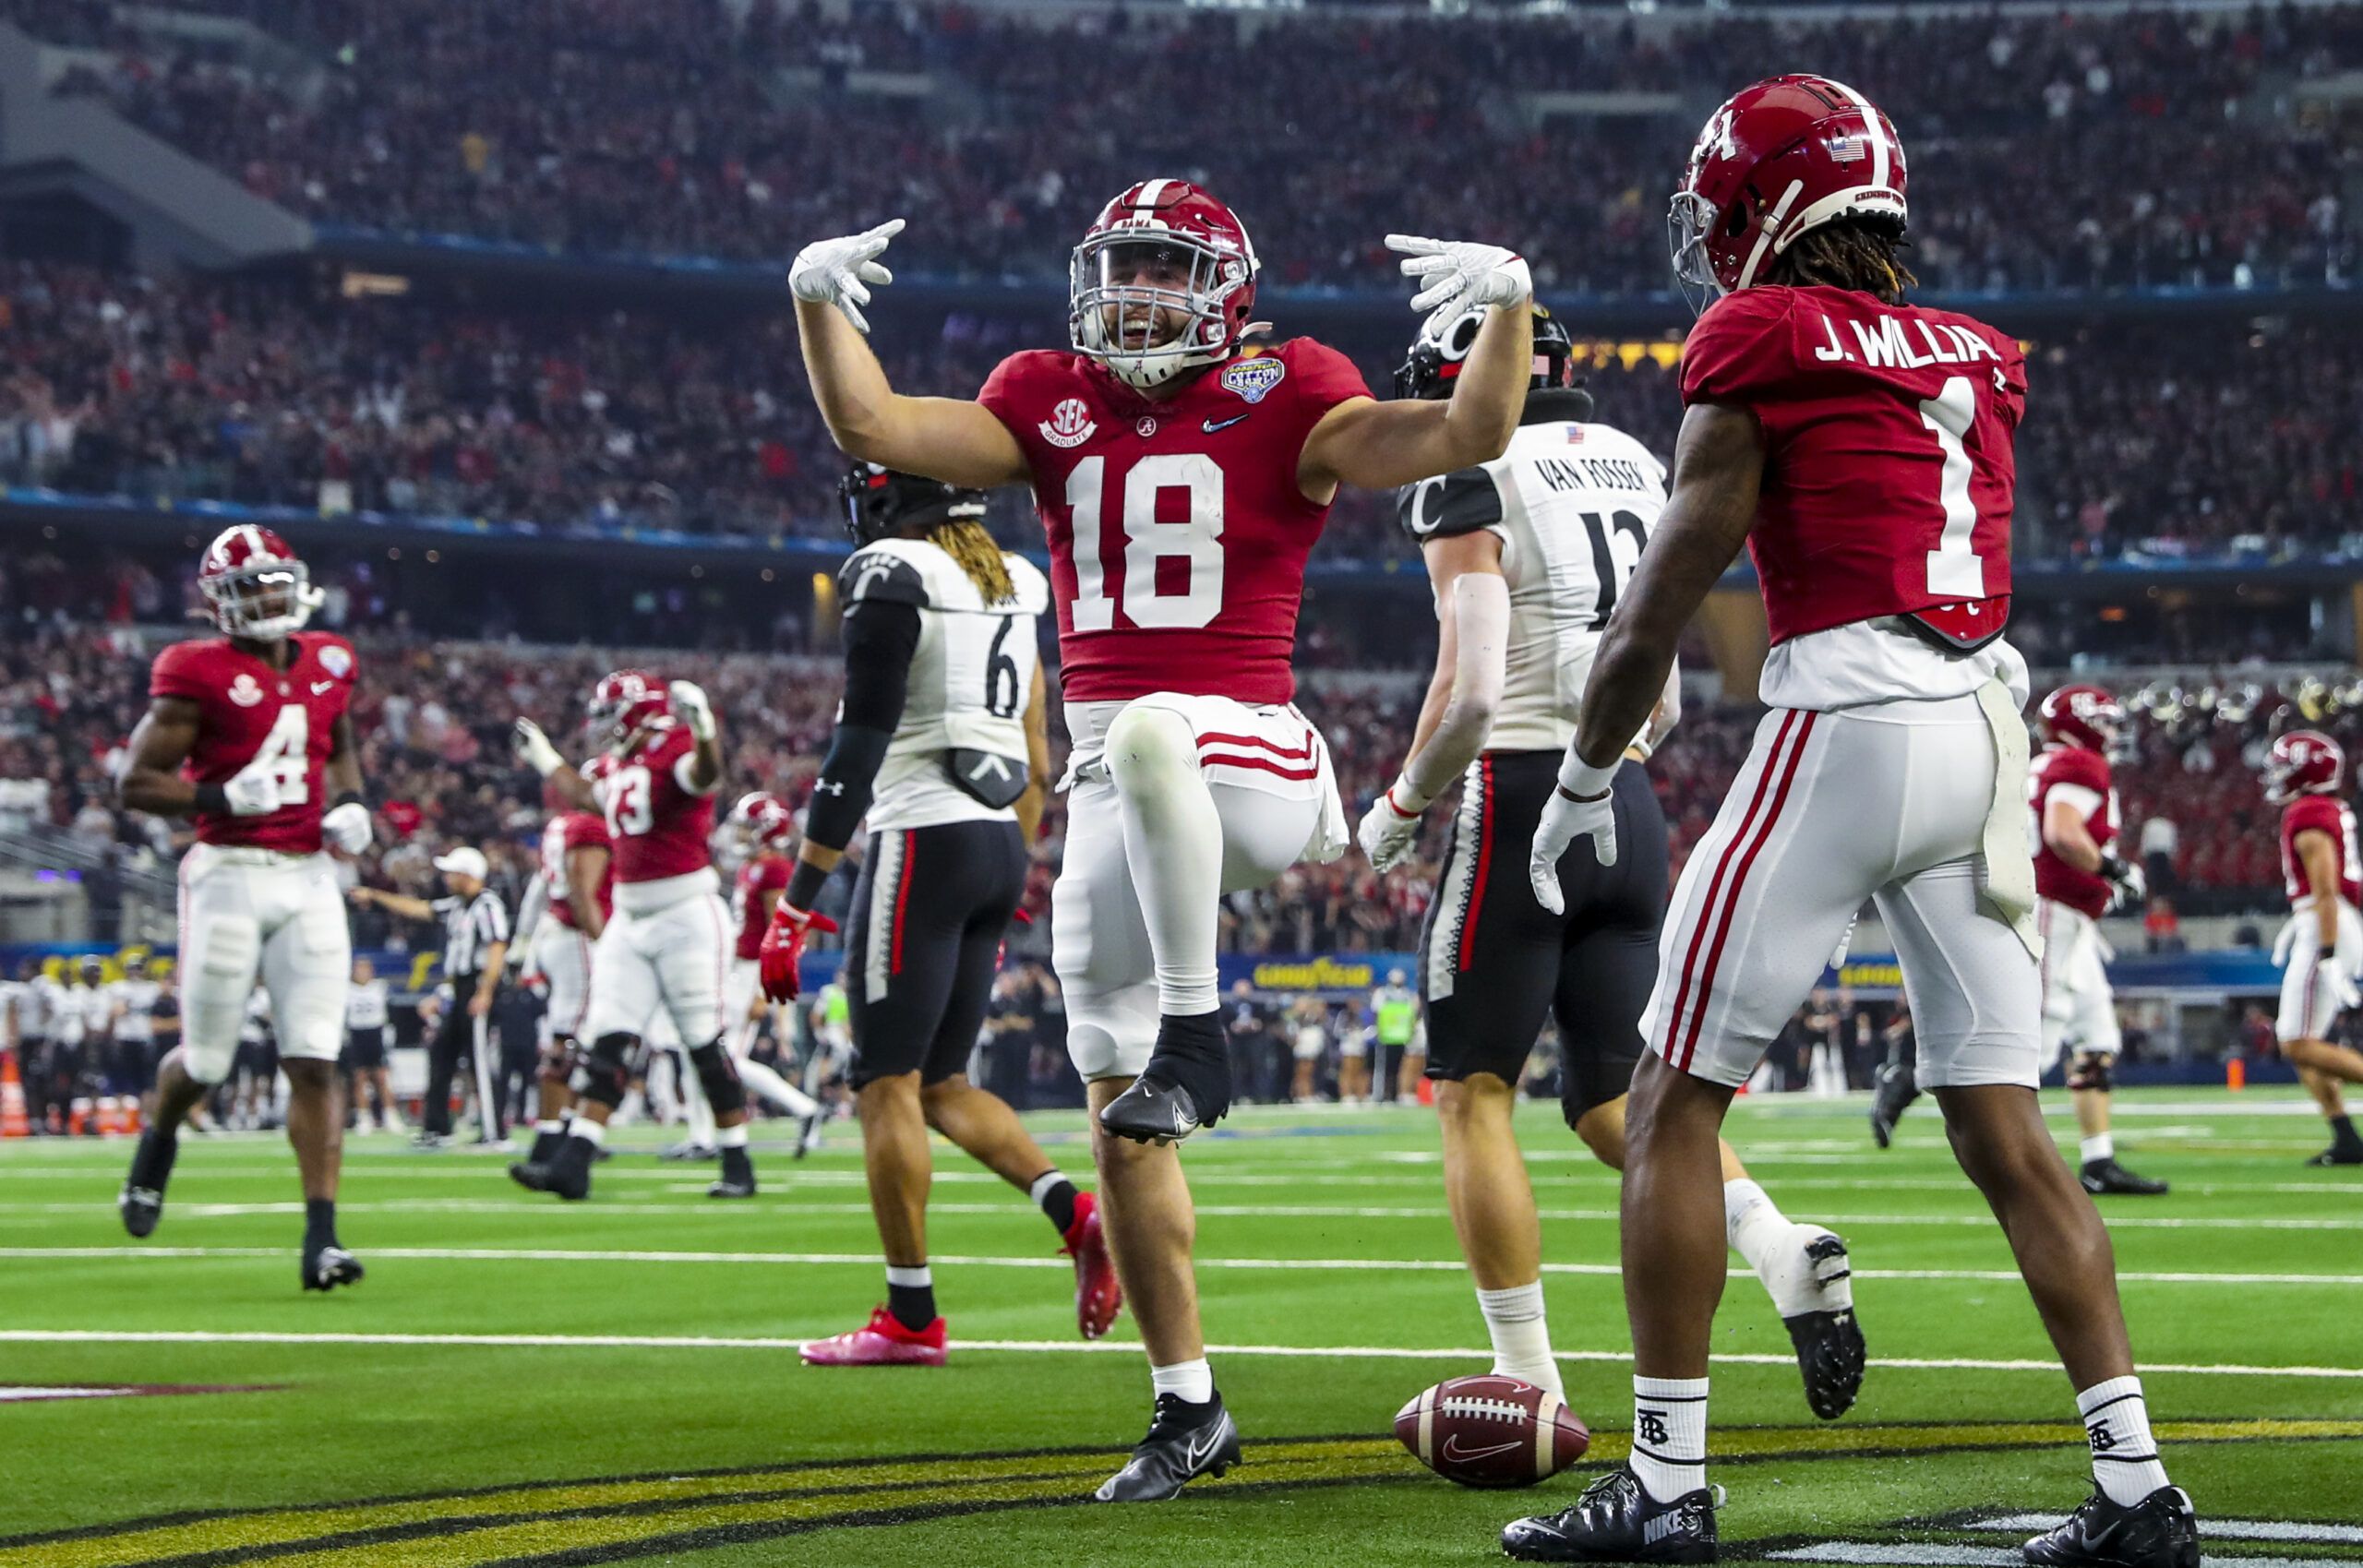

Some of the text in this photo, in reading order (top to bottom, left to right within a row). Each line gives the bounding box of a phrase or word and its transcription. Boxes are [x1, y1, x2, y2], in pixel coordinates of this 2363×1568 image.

[1044, 429, 1087, 446] GRADUATE
[1053, 398, 1087, 434] SEC
[1411, 476, 1446, 533] C
[1534, 459, 1586, 493] VAN
[1920, 376, 1985, 599] 1
[1065, 453, 1225, 632] 18
[987, 615, 1017, 718] 6
[255, 703, 309, 805] 4
[1643, 1508, 1684, 1546] NIKE
